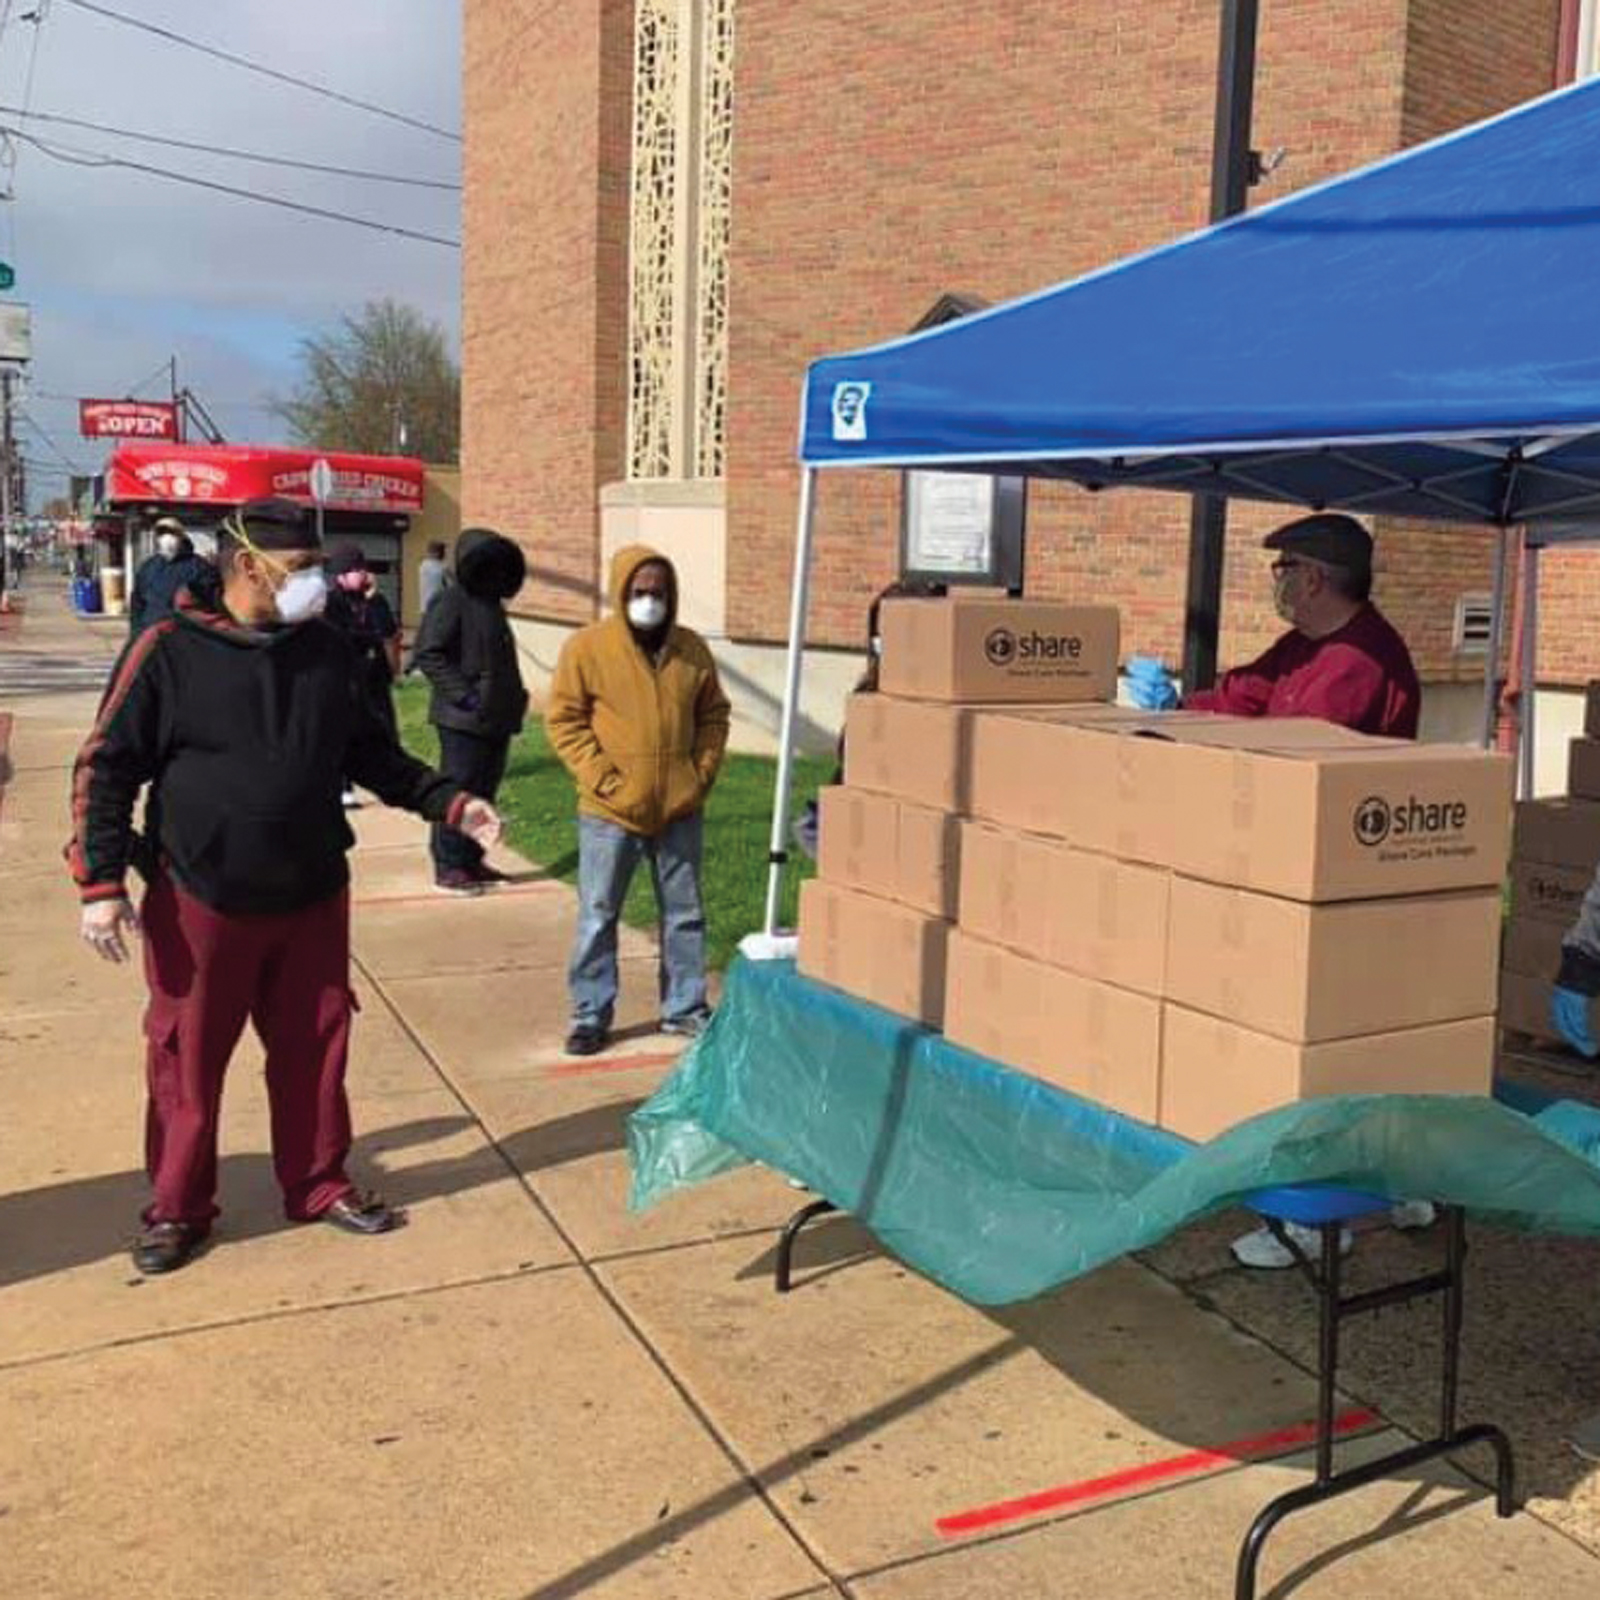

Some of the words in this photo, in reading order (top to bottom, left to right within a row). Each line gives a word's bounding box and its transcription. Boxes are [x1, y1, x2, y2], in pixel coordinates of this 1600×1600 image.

[109, 417, 164, 434] OPEN
[1019, 630, 1081, 658] share
[1391, 795, 1467, 834] share
